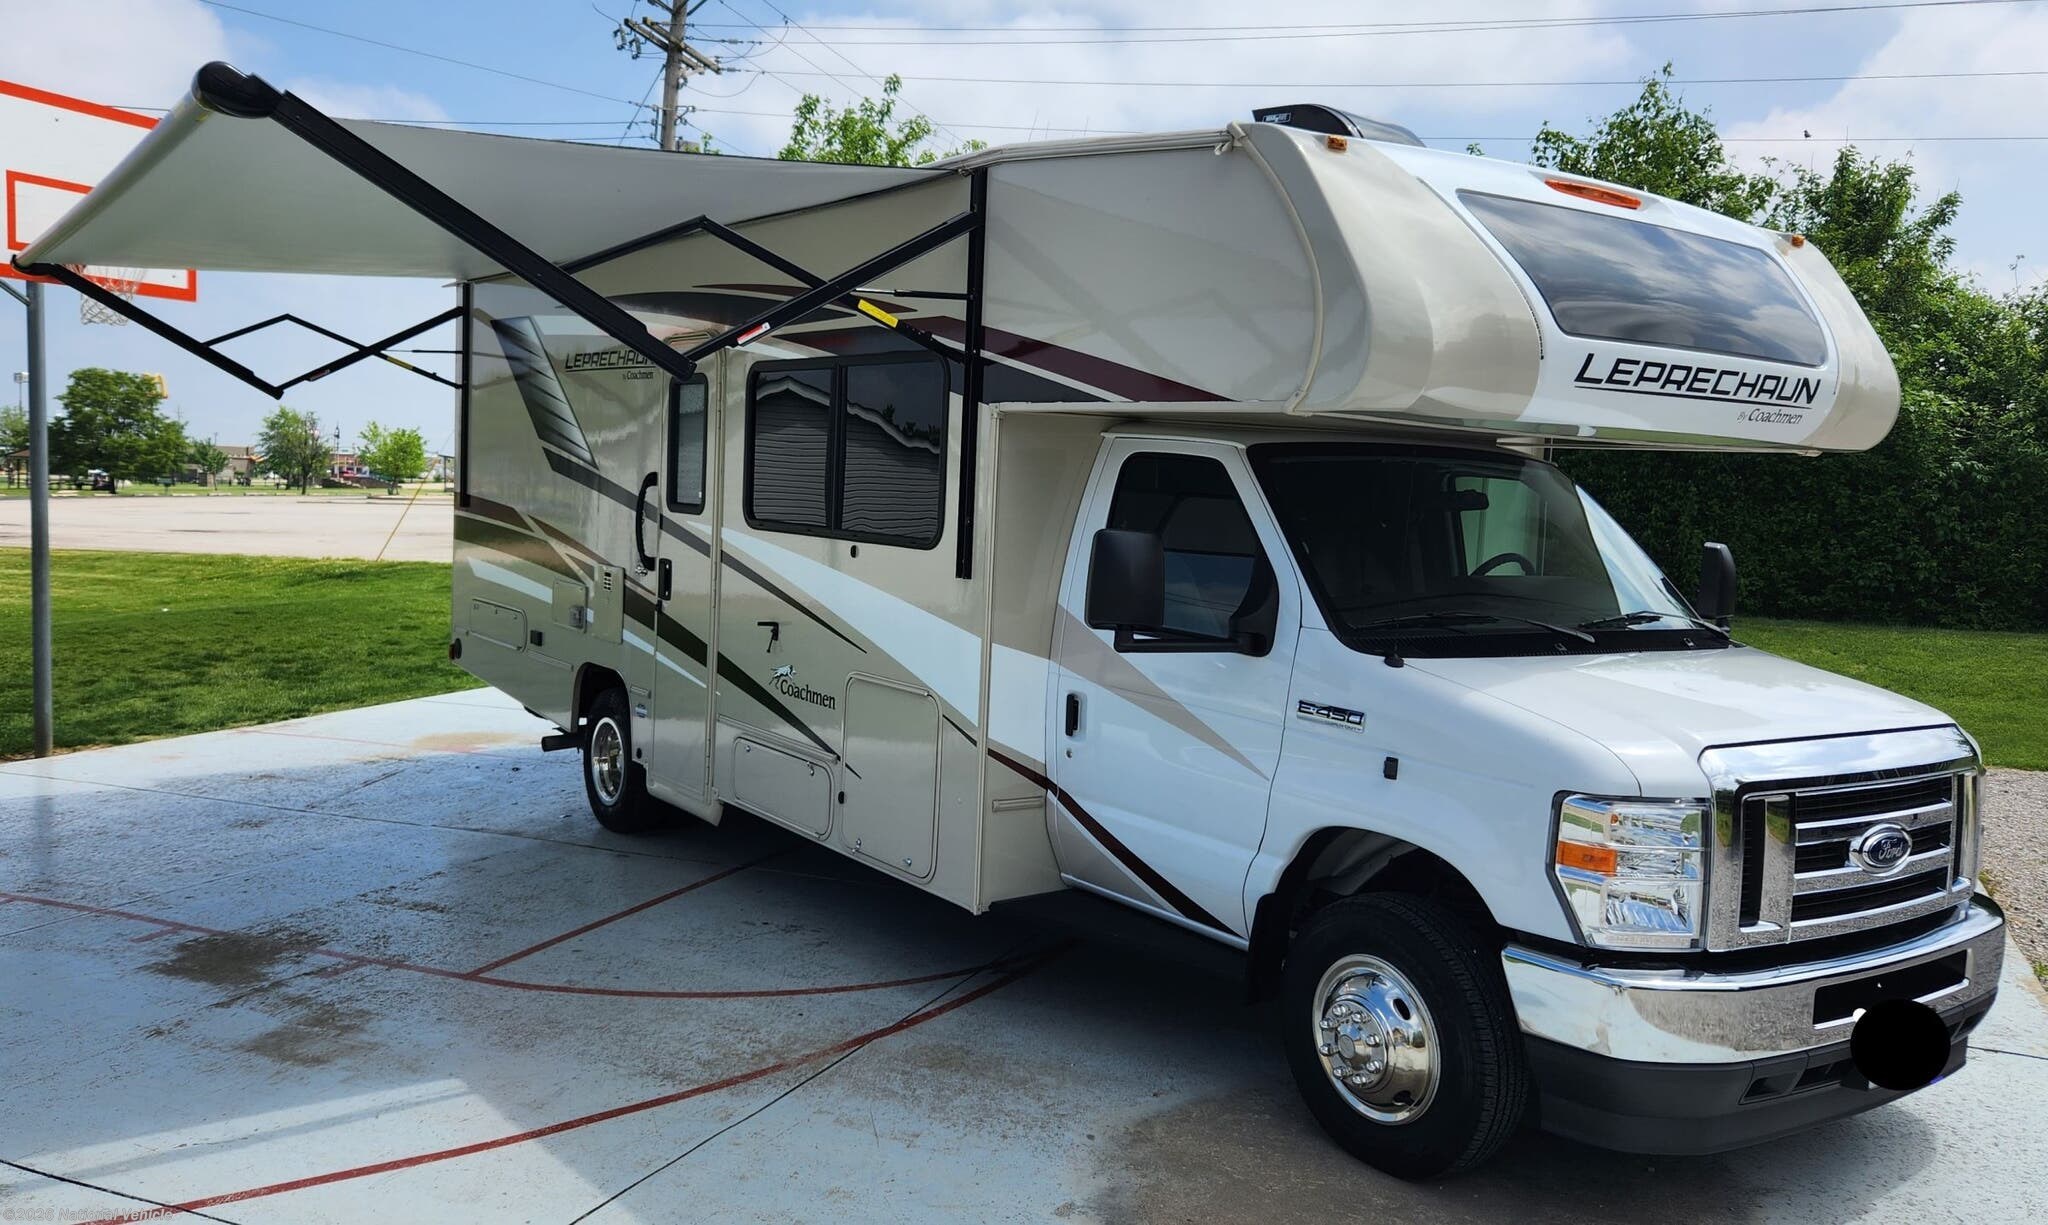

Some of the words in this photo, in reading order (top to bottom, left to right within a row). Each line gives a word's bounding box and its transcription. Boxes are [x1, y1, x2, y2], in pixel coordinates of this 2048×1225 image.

[565, 349, 655, 369] LEPRECHAU
[1575, 353, 1821, 404] LEPRECHAUN
[1748, 408, 1803, 424] Coachmen
[780, 679, 836, 710] Coachmen
[1879, 838, 1904, 860] Ford
